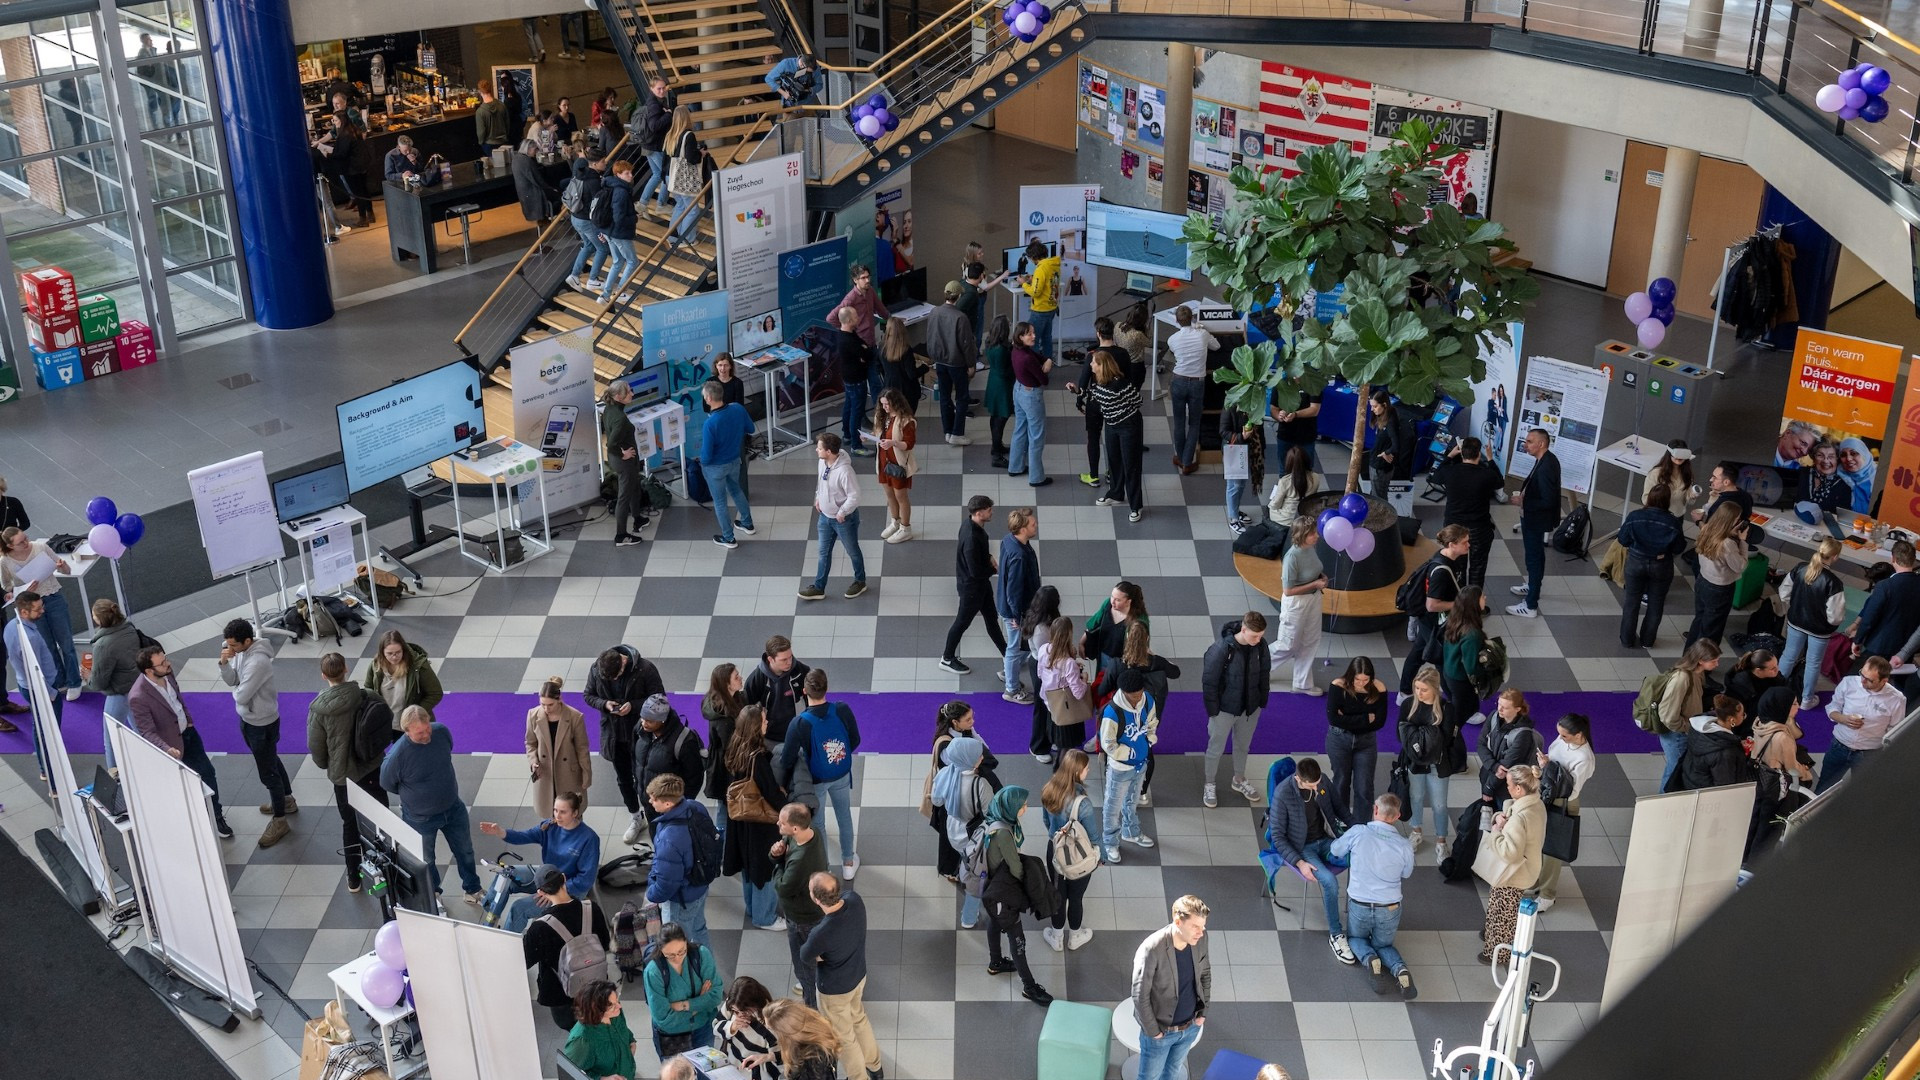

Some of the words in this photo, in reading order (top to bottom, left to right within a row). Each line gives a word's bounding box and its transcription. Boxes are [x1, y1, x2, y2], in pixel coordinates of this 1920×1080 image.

[1388, 106, 1398, 120] 6
[1378, 121, 1402, 134] MRT
[1432, 133, 1460, 146] OND
[786, 160, 798, 169] ZU
[728, 174, 743, 184] Zuyd
[728, 178, 764, 192] Hogeschool
[83, 310, 88, 319] 3
[1807, 341, 1828, 354] Een
[1833, 348, 1864, 361] warm
[540, 363, 567, 377] beter
[1805, 354, 1838, 370] thuis...
[1803, 366, 1834, 380] Dáár
[1836, 374, 1880, 392] zorgen
[522, 393, 545, 404] beweeg
[562, 379, 588, 391] verander
[1801, 379, 1819, 392] wij
[1822, 384, 1854, 398] voor!
[348, 400, 391, 423] Background
[399, 394, 413, 404] Aim
